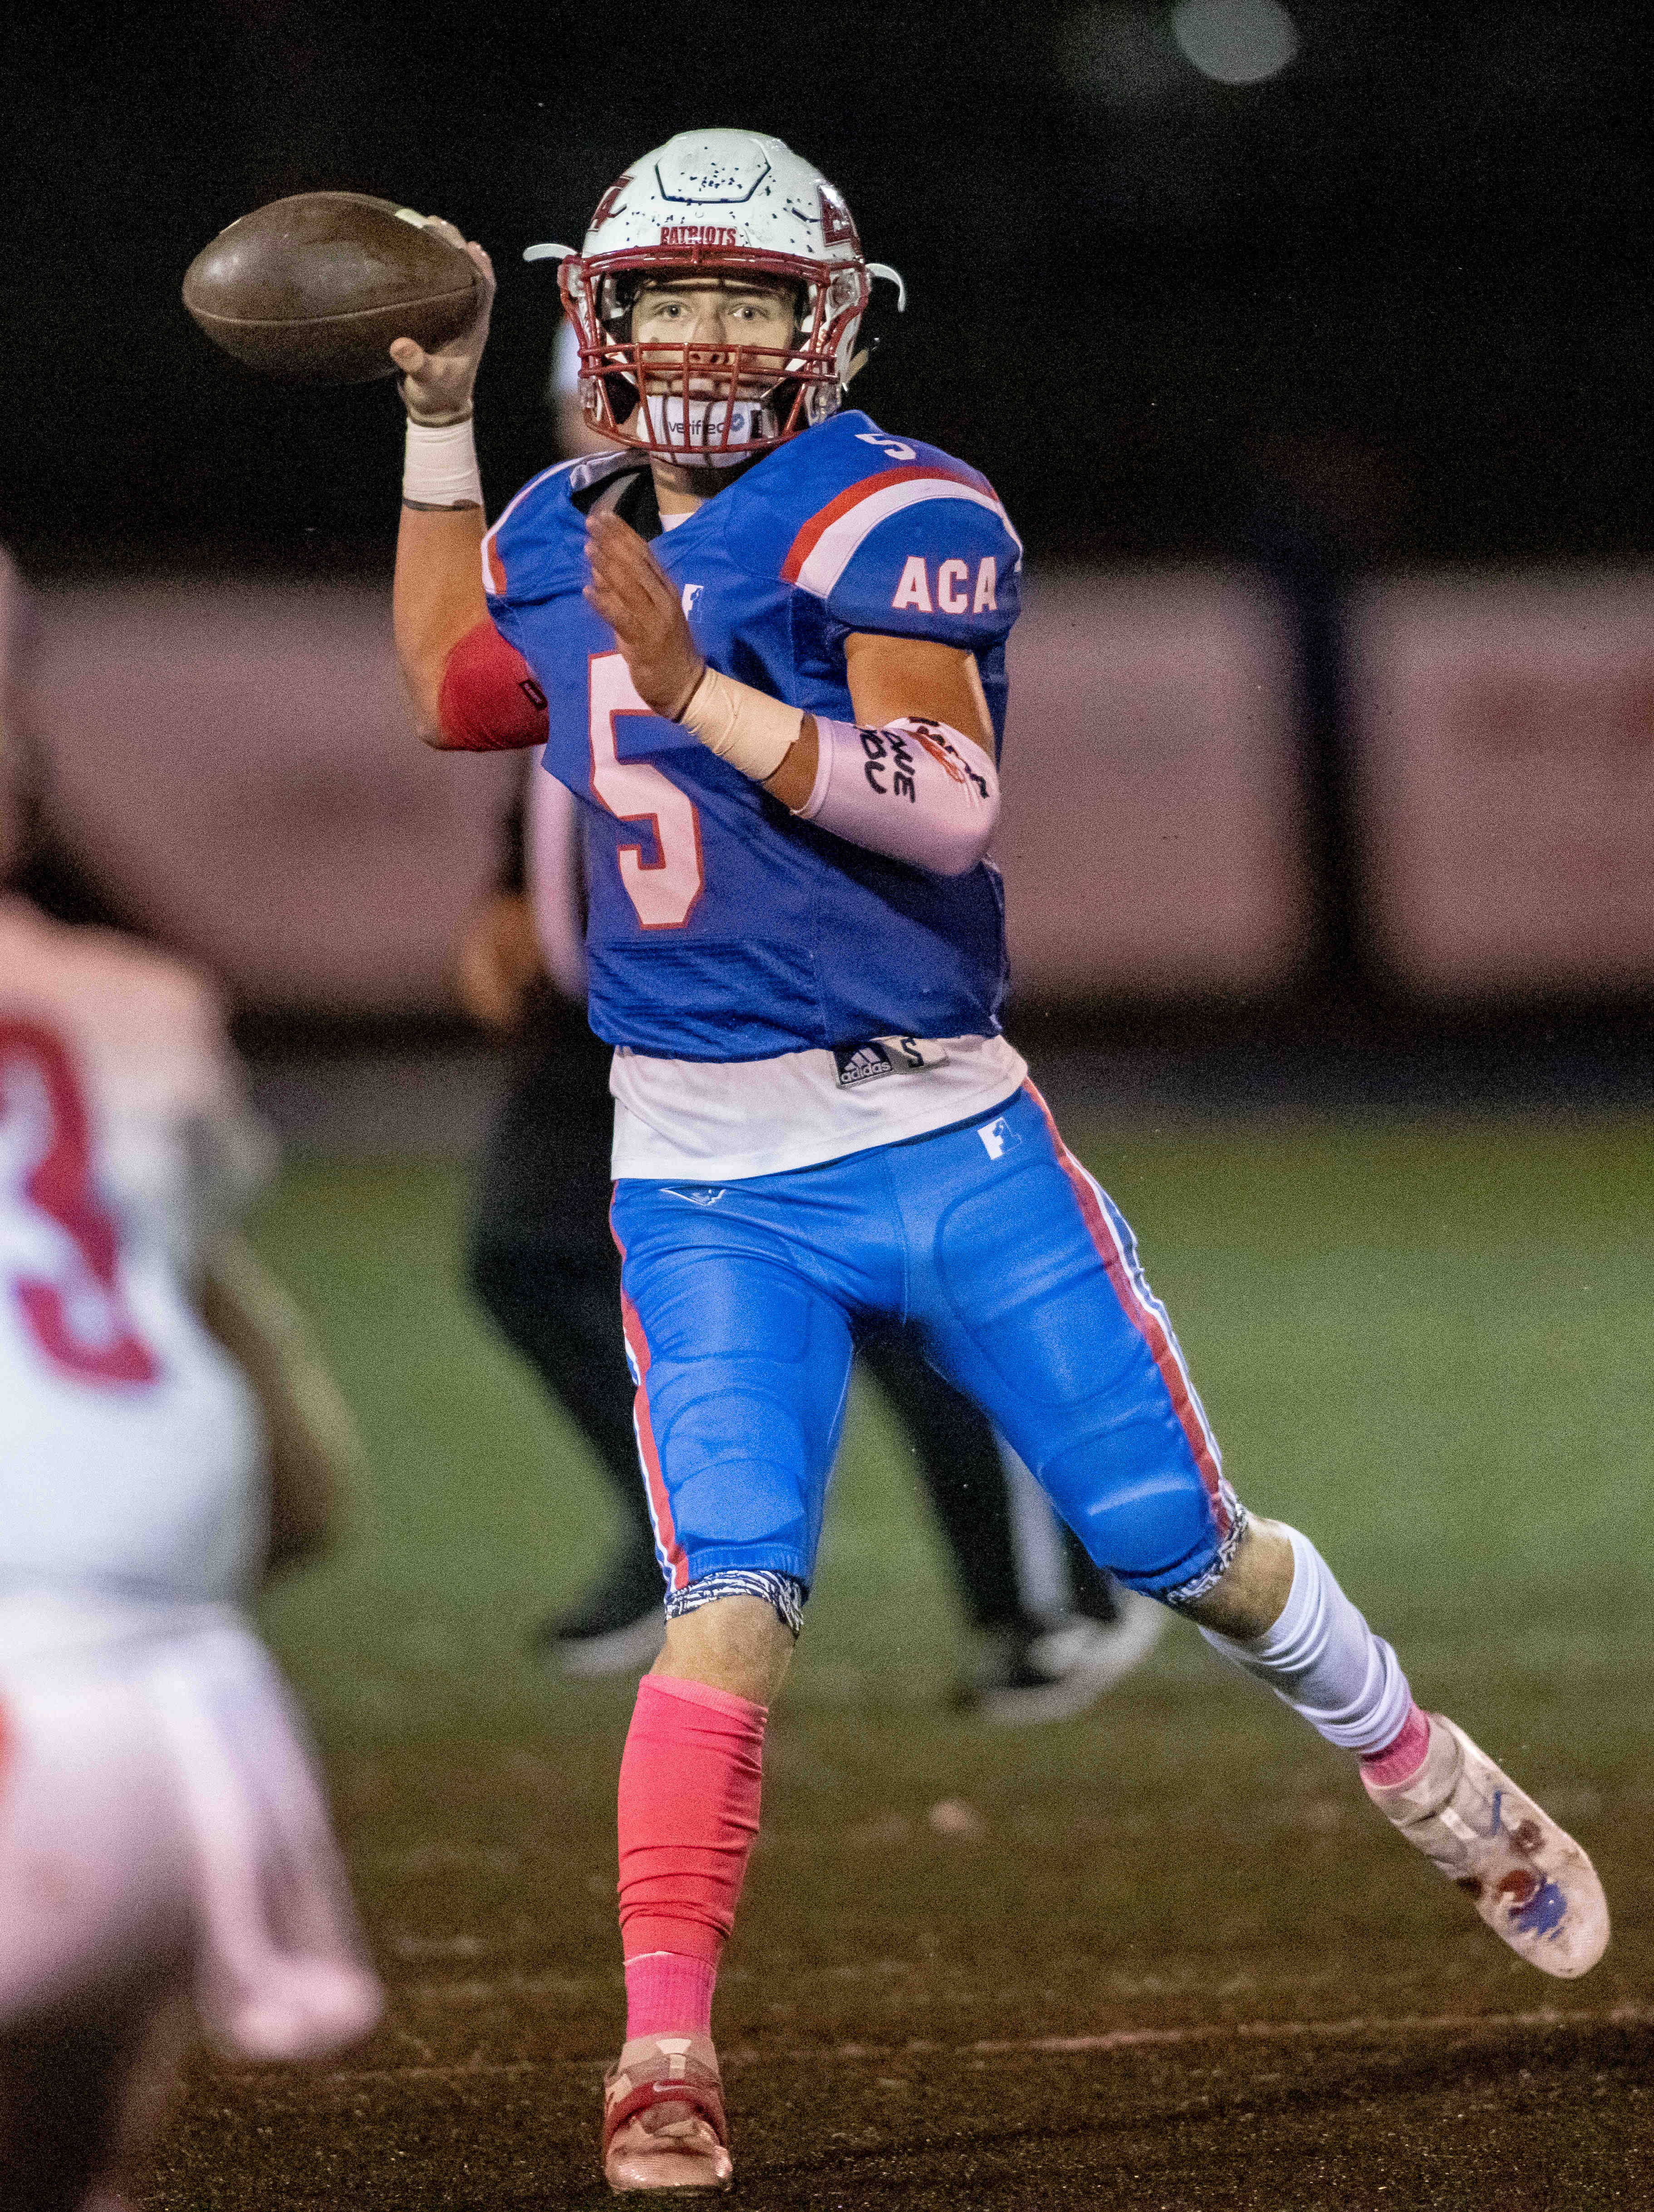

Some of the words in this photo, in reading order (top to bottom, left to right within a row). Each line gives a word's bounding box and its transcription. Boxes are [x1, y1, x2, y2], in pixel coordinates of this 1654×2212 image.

[660, 226, 736, 245] PATRIOTS
[667, 419, 726, 435] veifed
[855, 433, 916, 460] 5
[891, 555, 998, 614] ACA
[588, 651, 704, 930] 5
[841, 1061, 892, 1082] adidas
